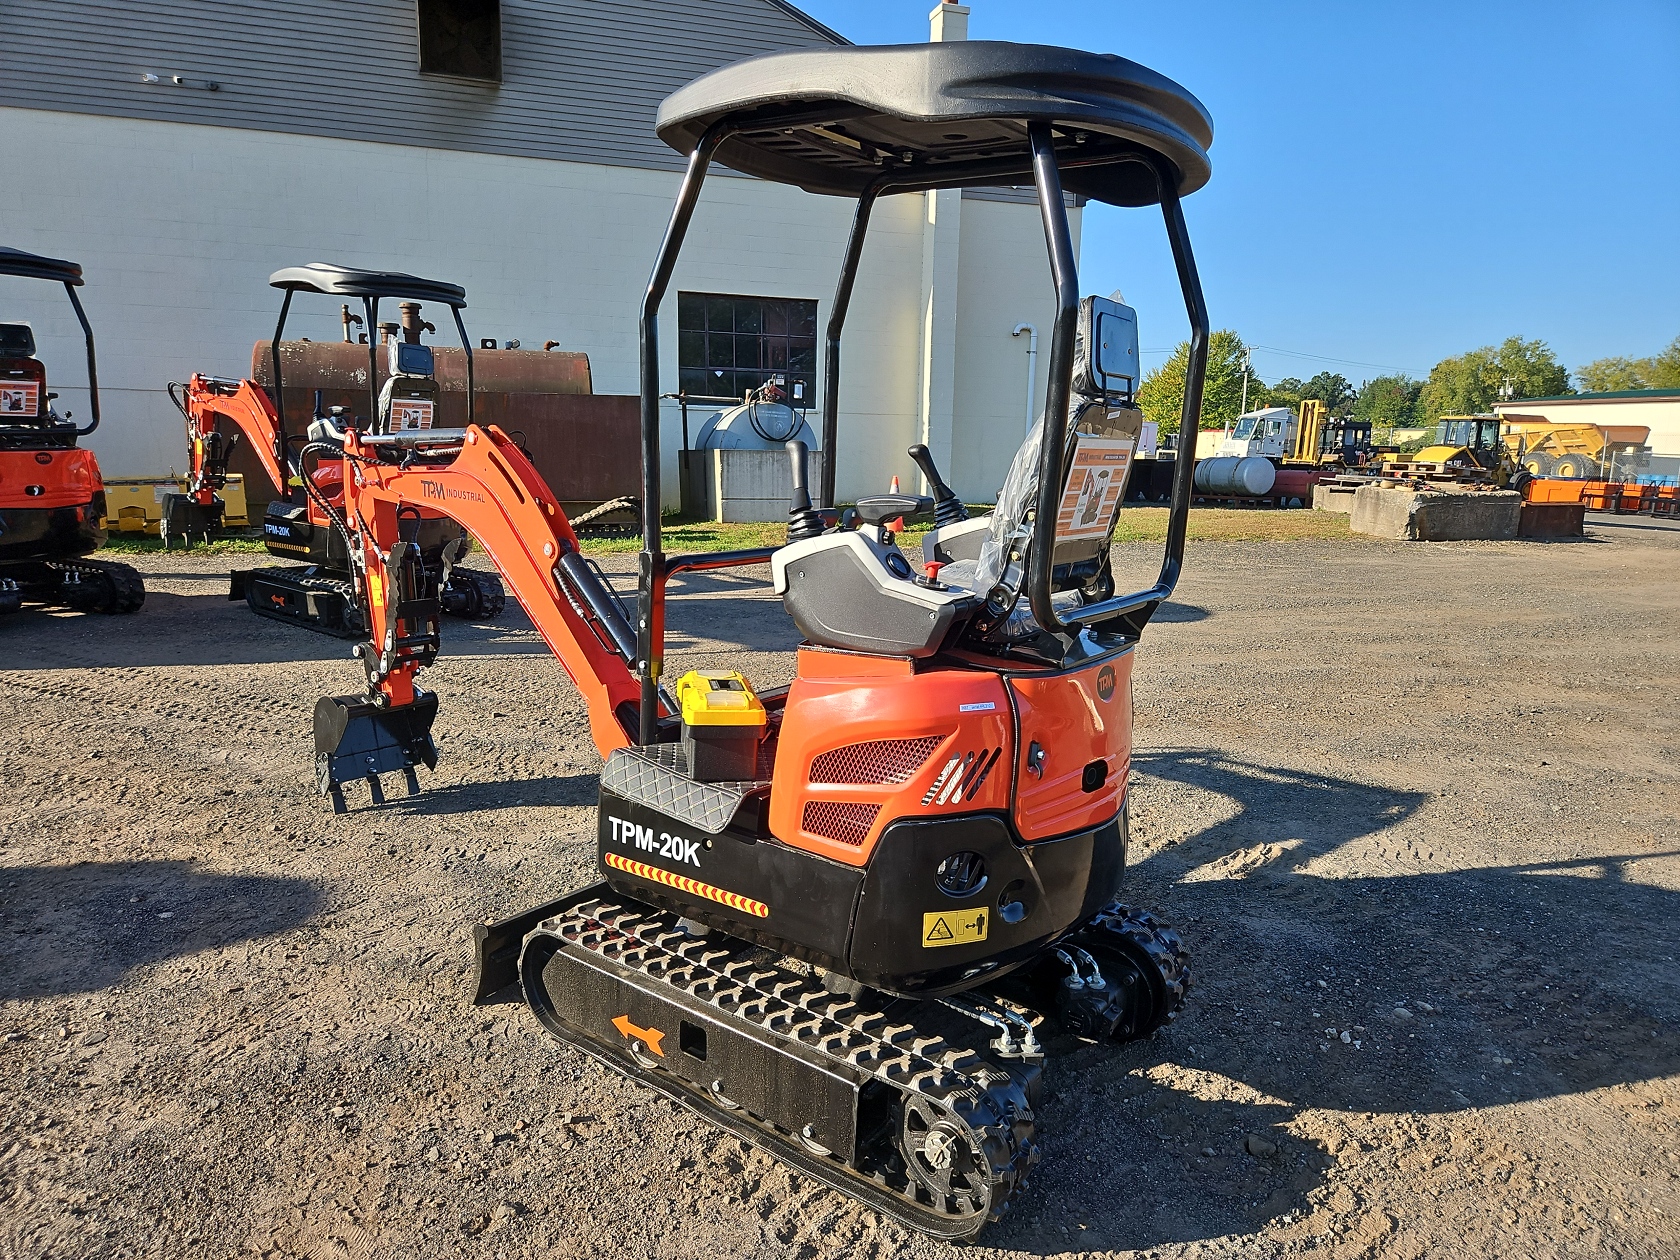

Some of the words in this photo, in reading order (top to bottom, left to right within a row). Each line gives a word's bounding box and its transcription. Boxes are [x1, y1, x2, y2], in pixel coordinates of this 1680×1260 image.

[421, 480, 445, 500] TPM
[446, 488, 485, 503] INDUSTRIAL
[265, 524, 290, 537] TPM-20K
[1099, 674, 1113, 691] TPM
[608, 815, 701, 868] TPM-20K
